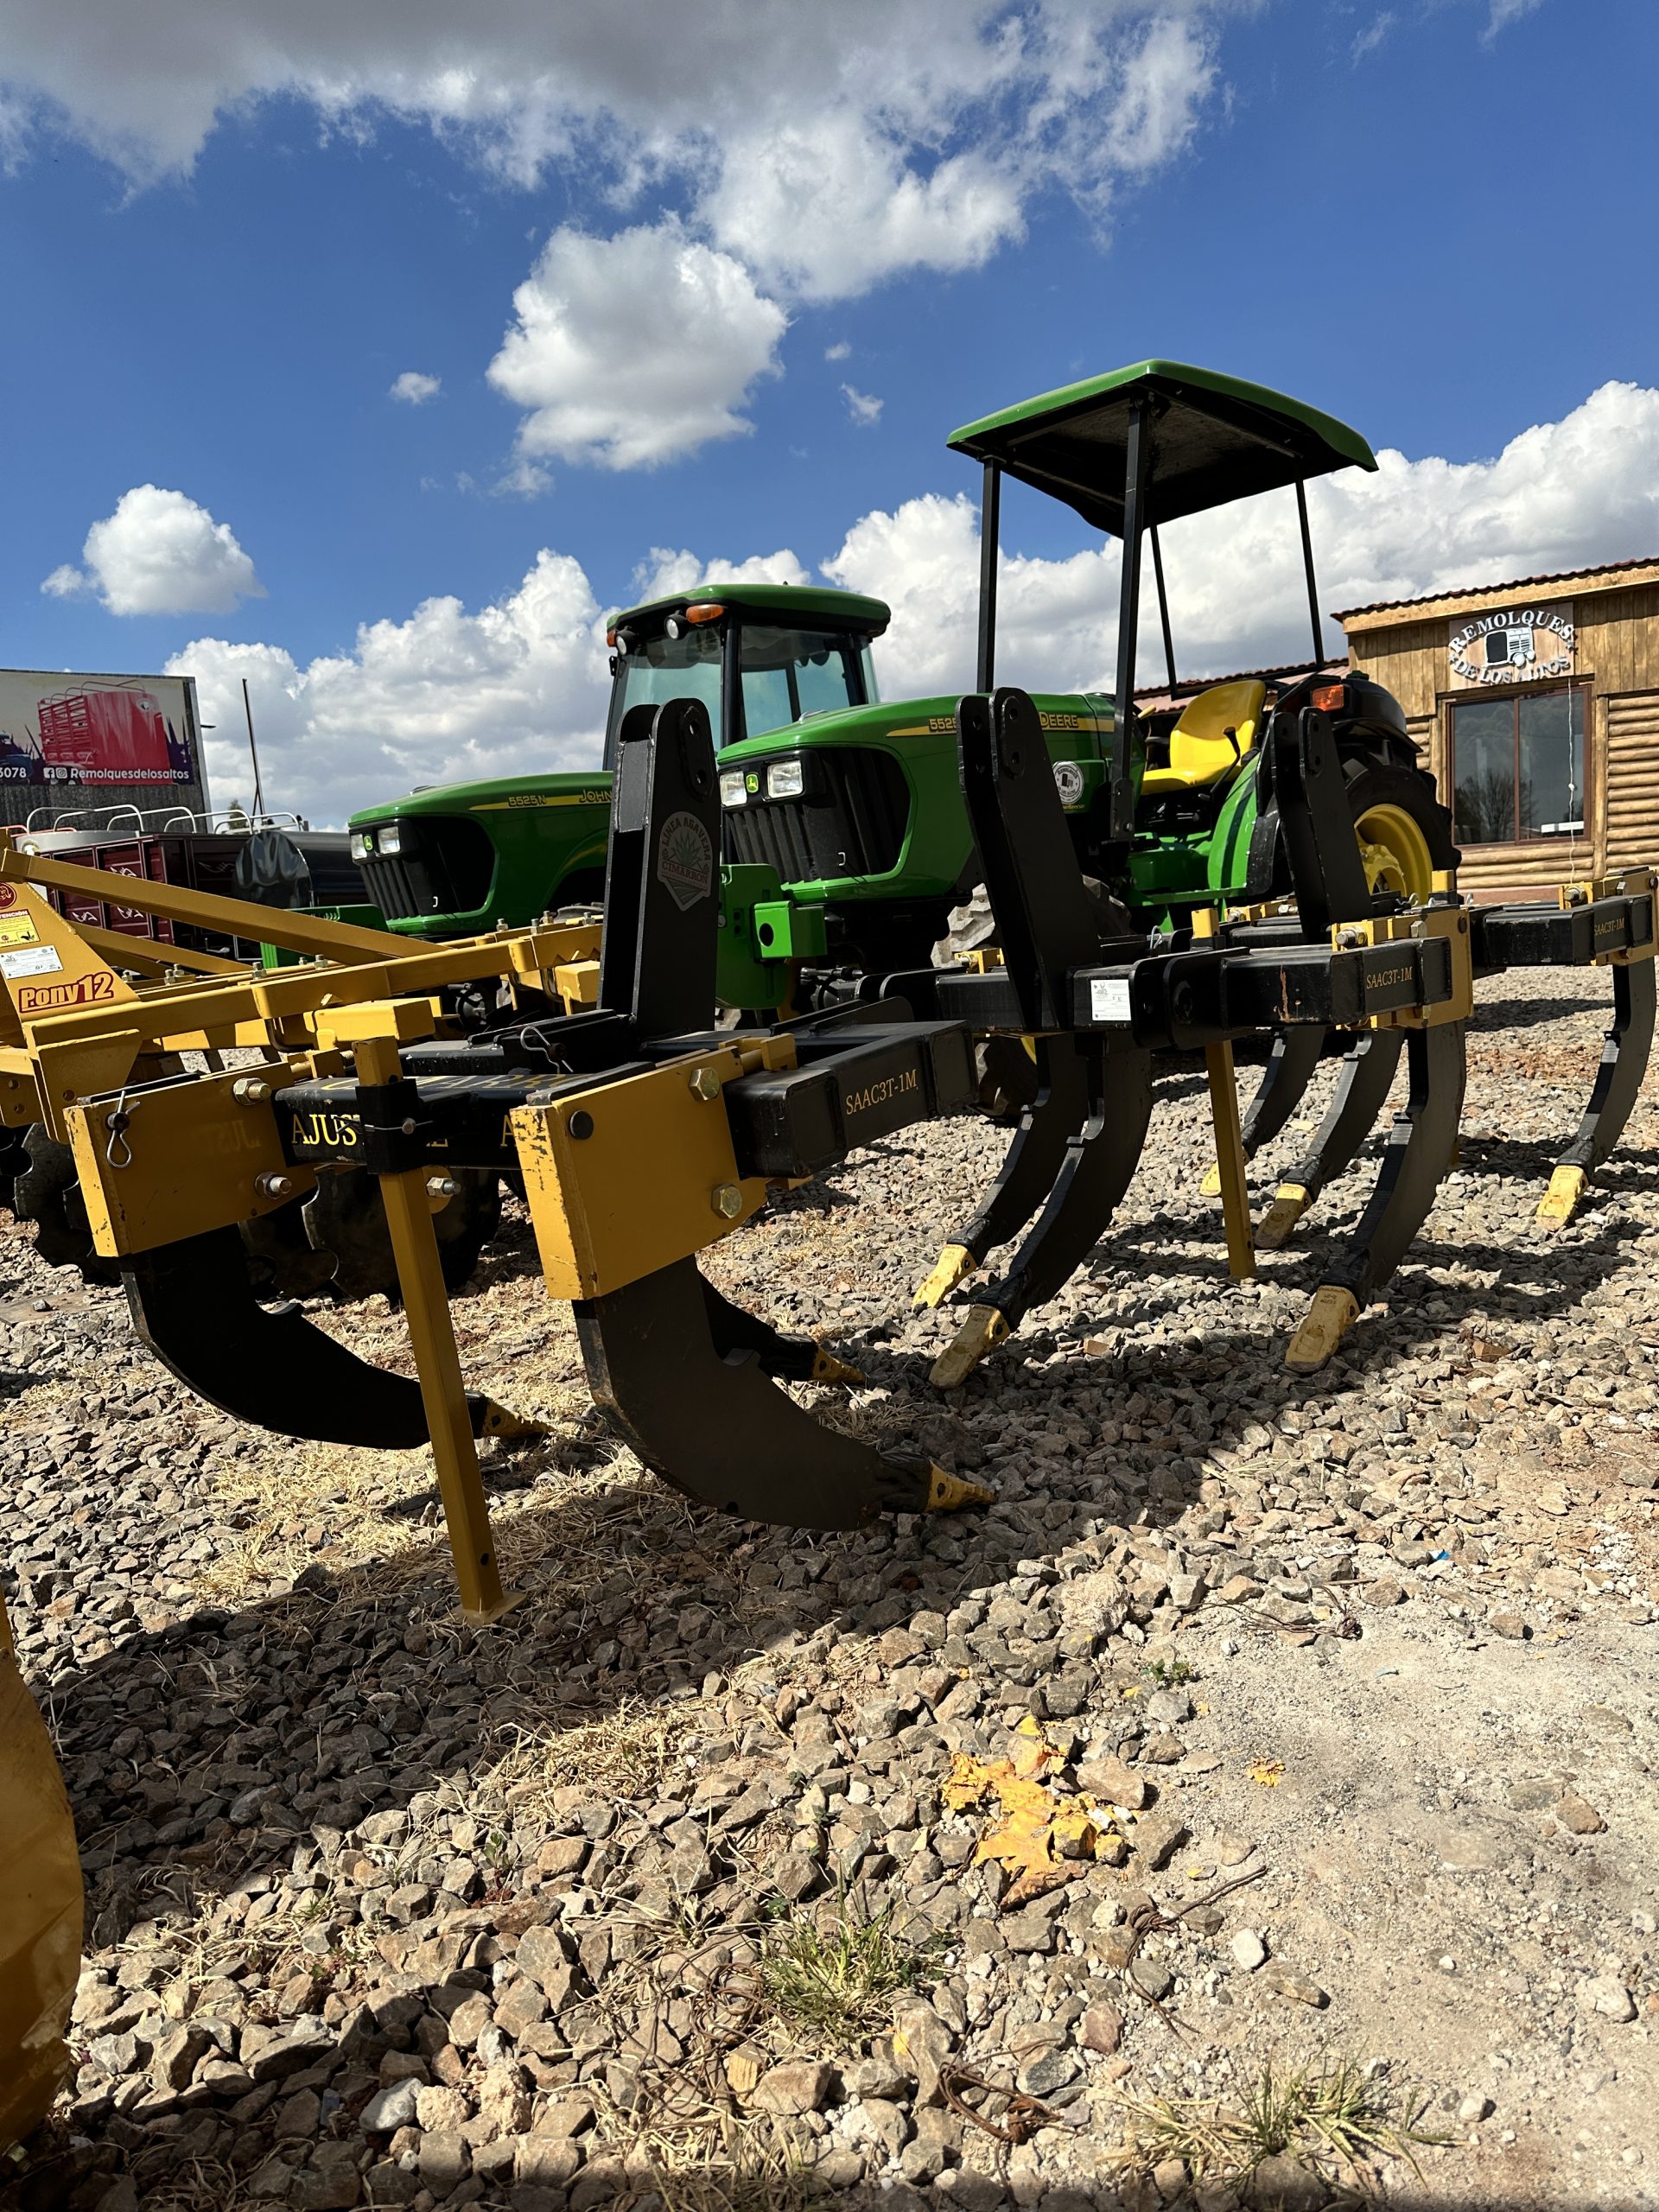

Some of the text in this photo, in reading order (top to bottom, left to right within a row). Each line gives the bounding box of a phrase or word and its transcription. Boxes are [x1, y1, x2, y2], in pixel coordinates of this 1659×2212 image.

[1448, 610, 1574, 653] REMOLQUES
[1454, 655, 1571, 685] DE LOS ALTOS
[1039, 711, 1078, 728] DEERE
[70, 767, 189, 780] Remolquesdelosaltos
[508, 795, 546, 807] 5525N
[662, 861, 709, 885] CIMARRON
[1366, 966, 1413, 989] SAAC3T-1M
[846, 1068, 917, 1116] SAAC3T-1M
